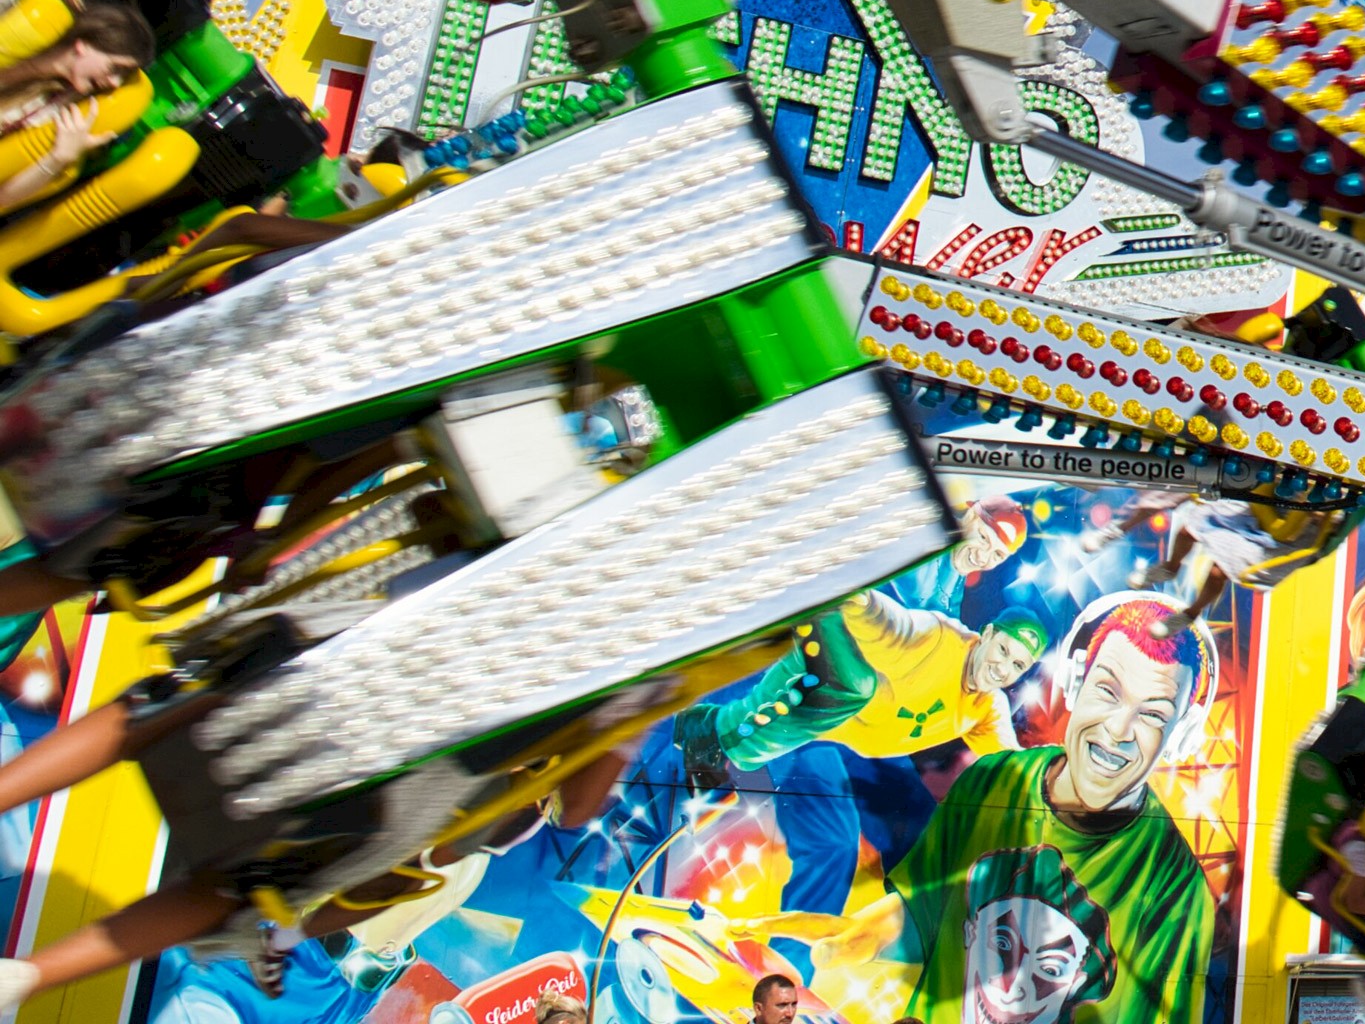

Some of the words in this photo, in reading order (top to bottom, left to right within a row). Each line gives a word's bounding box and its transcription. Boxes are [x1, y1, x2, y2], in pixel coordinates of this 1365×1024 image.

[1252, 207, 1337, 260] Power
[937, 442, 1013, 466] Power
[1021, 449, 1045, 469] to
[1054, 452, 1093, 472] the
[1100, 458, 1185, 481] people
